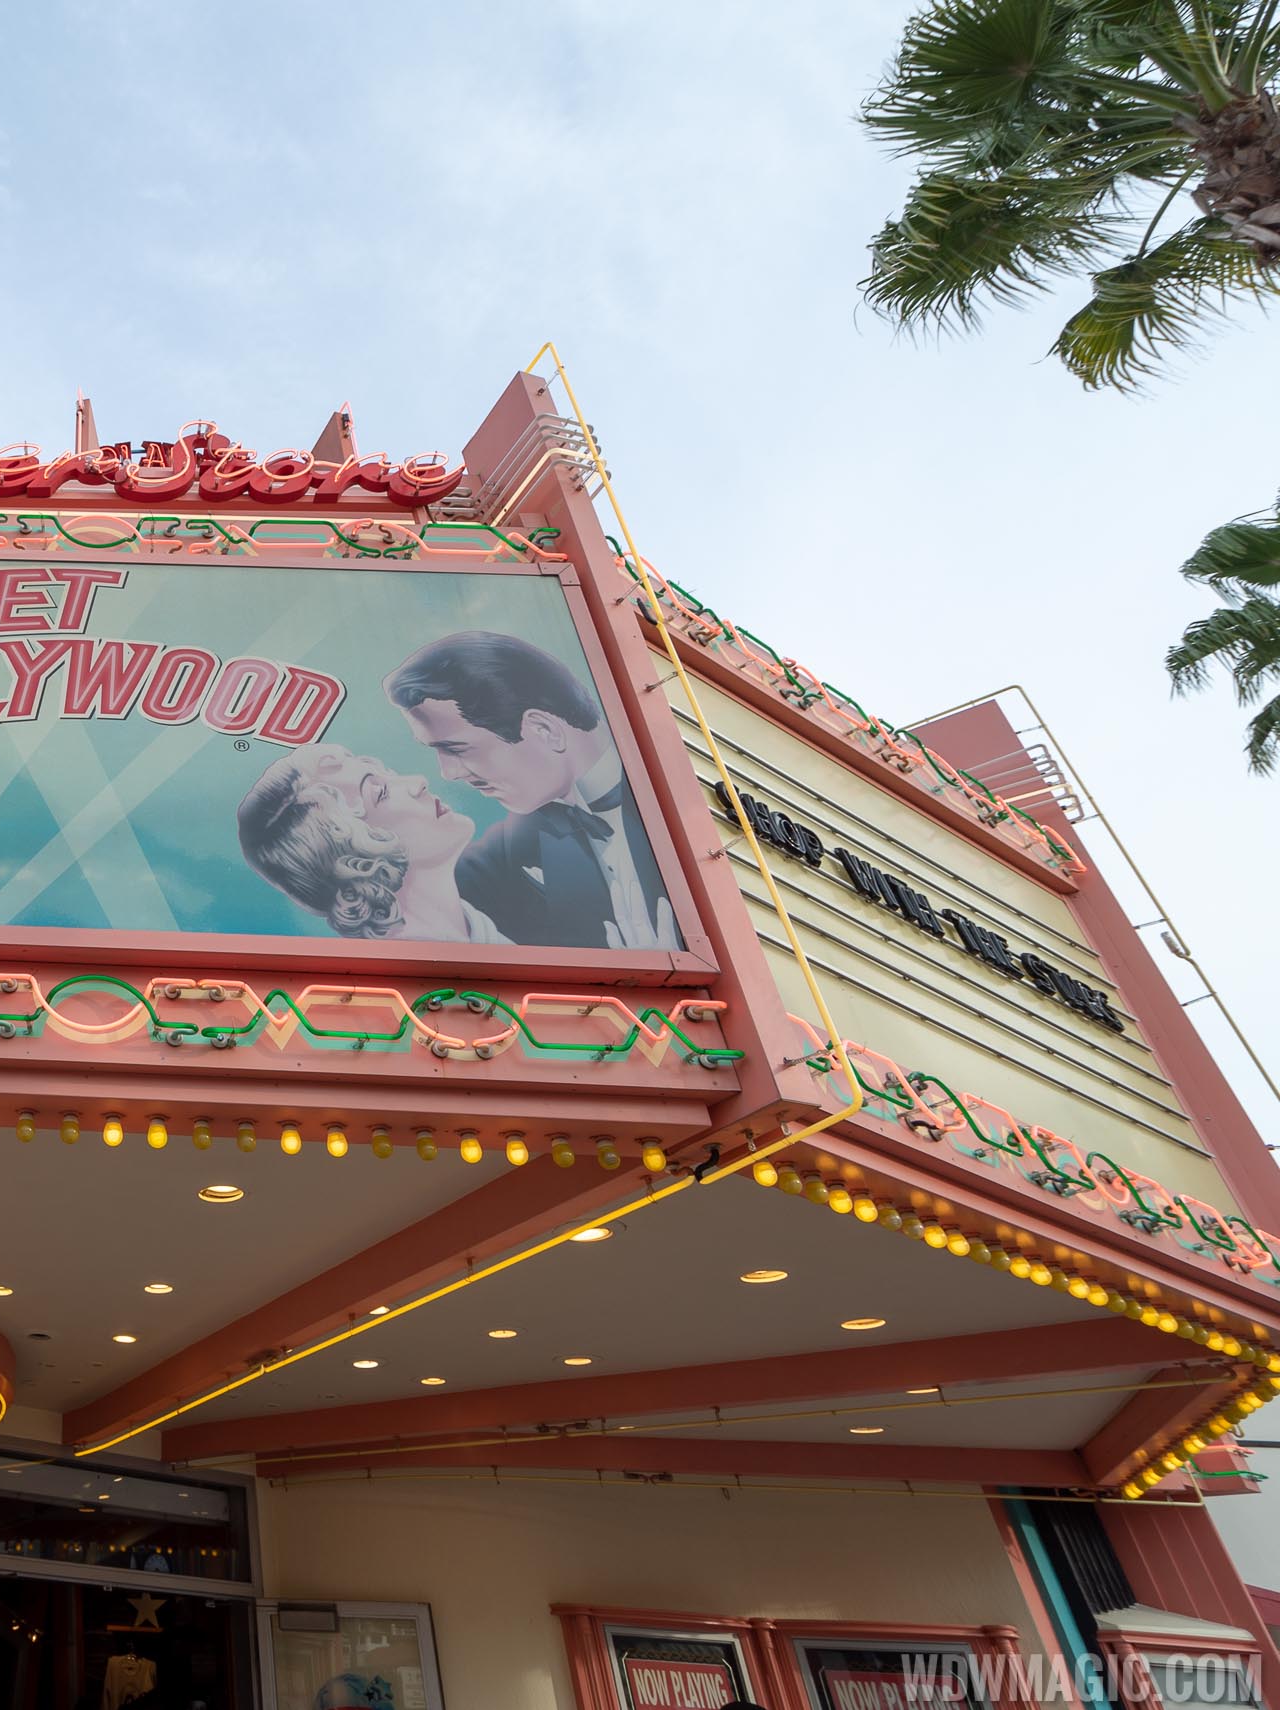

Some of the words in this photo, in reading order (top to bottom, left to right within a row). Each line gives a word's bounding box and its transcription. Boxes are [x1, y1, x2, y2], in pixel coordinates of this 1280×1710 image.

[714, 781, 824, 868] SHOP
[834, 847, 946, 938] WITH
[942, 908, 1024, 981] THE
[632, 1667, 671, 1707] NOW
[669, 1670, 729, 1710] PLAYING
[832, 1679, 881, 1710] NOW
